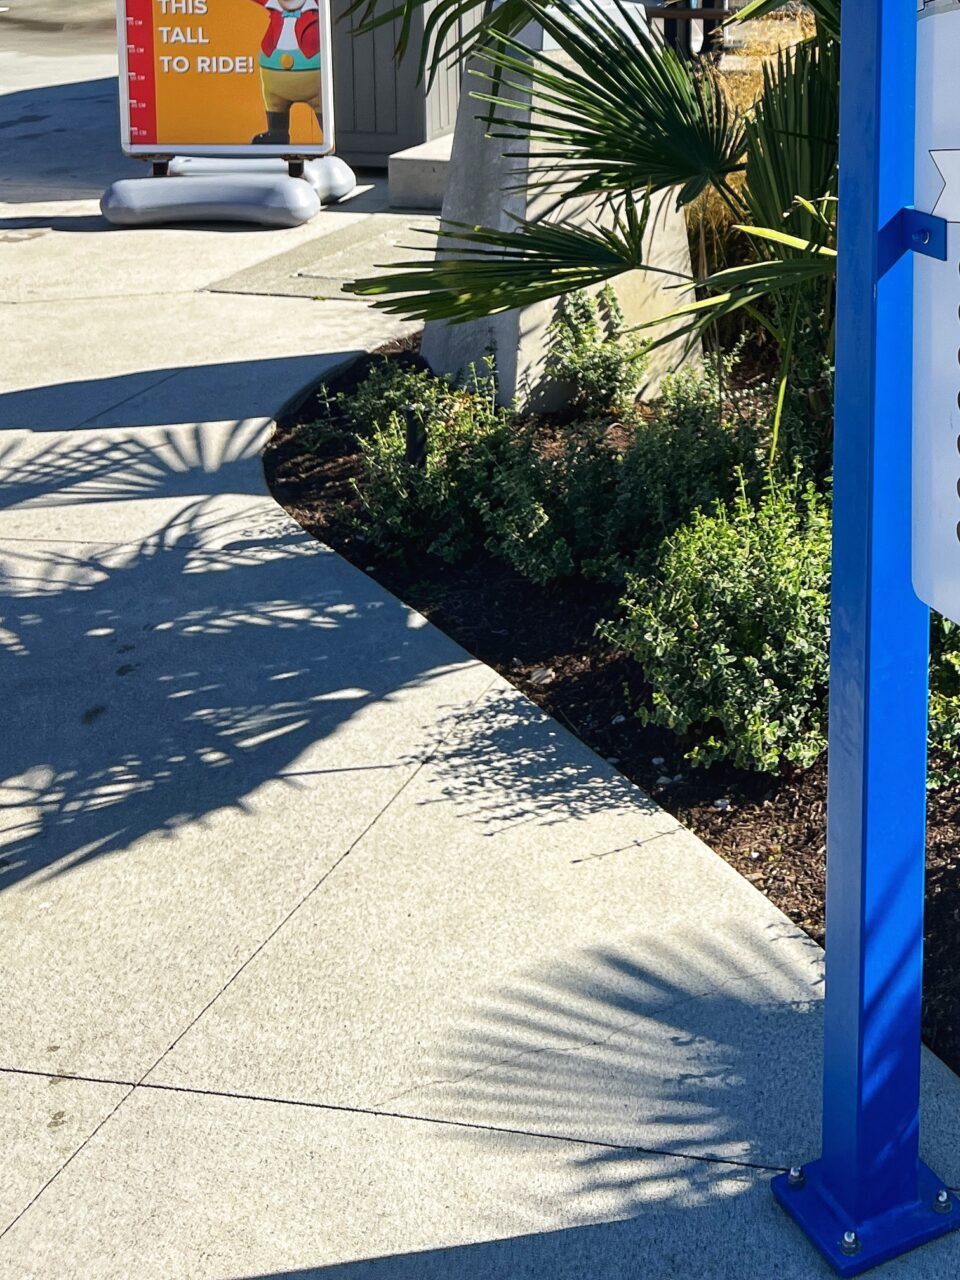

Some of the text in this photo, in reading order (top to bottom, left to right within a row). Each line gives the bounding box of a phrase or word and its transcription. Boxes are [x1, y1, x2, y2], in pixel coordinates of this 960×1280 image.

[158, 26, 209, 44] TALL
[160, 55, 254, 74] TO RIDE!
